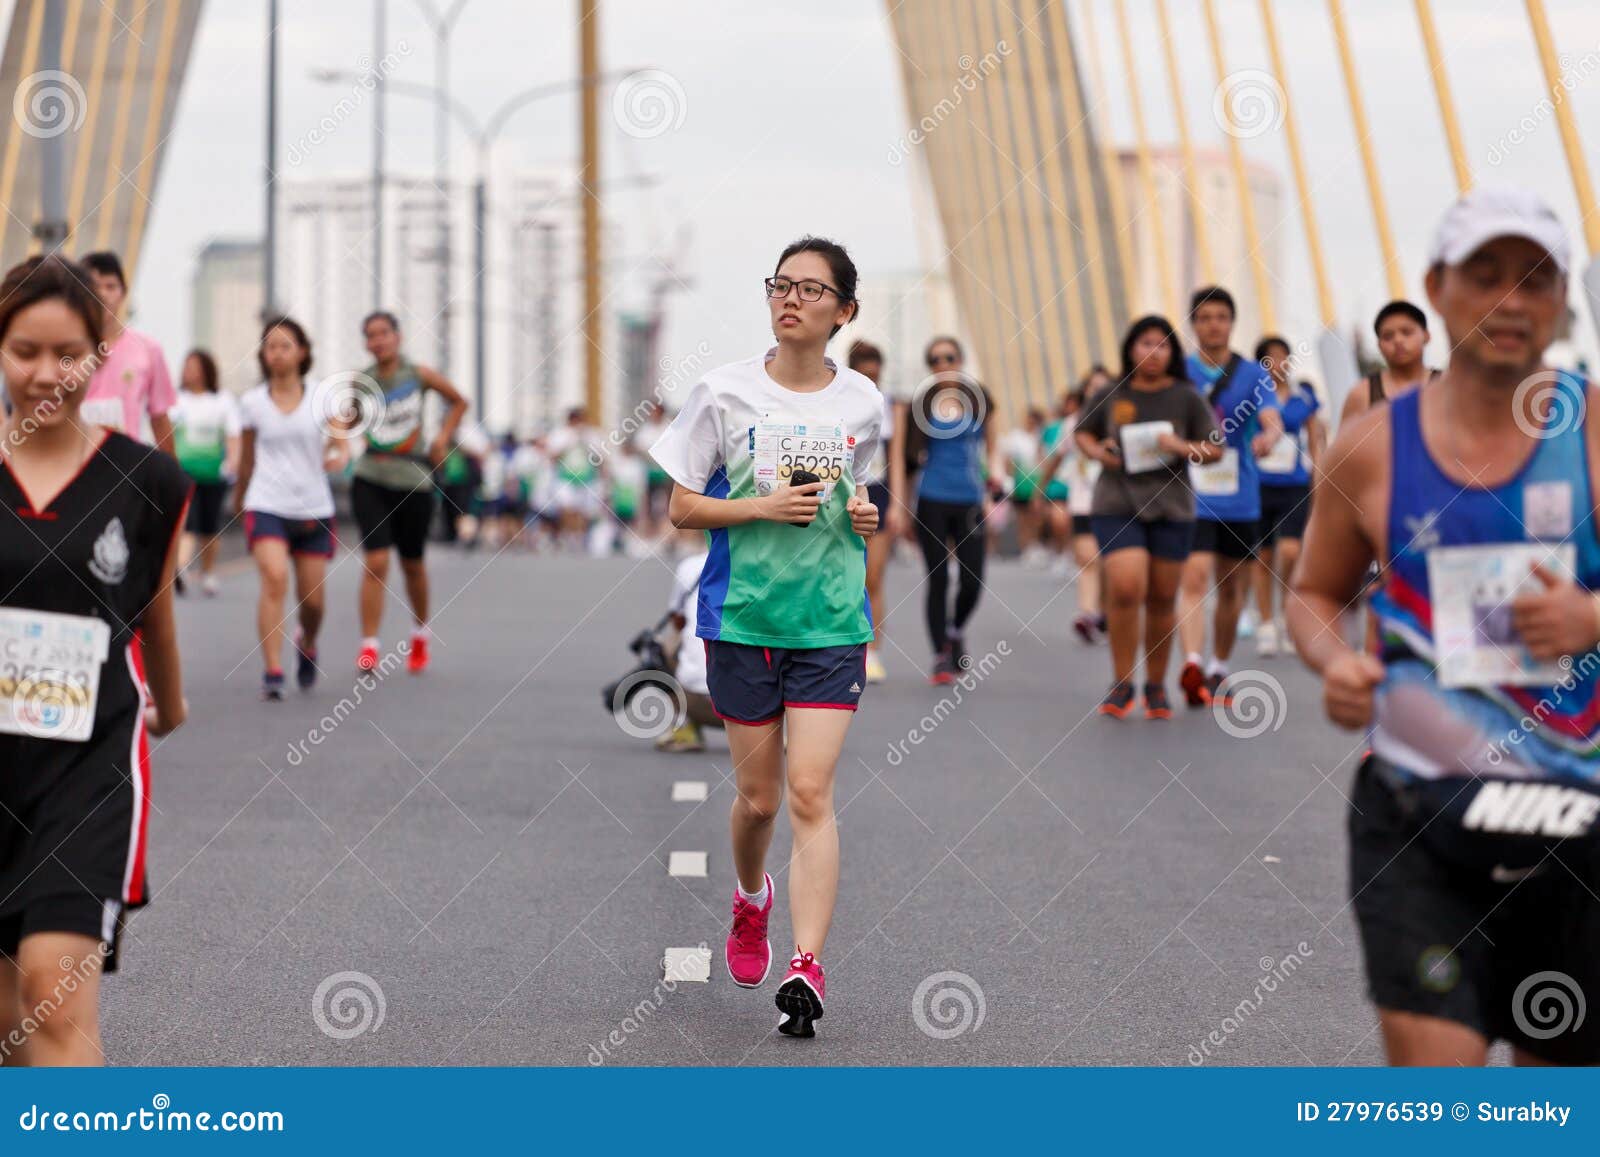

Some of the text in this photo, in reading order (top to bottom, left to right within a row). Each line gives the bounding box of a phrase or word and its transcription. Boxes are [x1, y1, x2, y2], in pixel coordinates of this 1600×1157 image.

[780, 437, 792, 451] C
[800, 440, 808, 451] F
[811, 440, 844, 452] 20-34
[780, 454, 842, 481] 35235
[1462, 780, 1600, 837] NIKE
